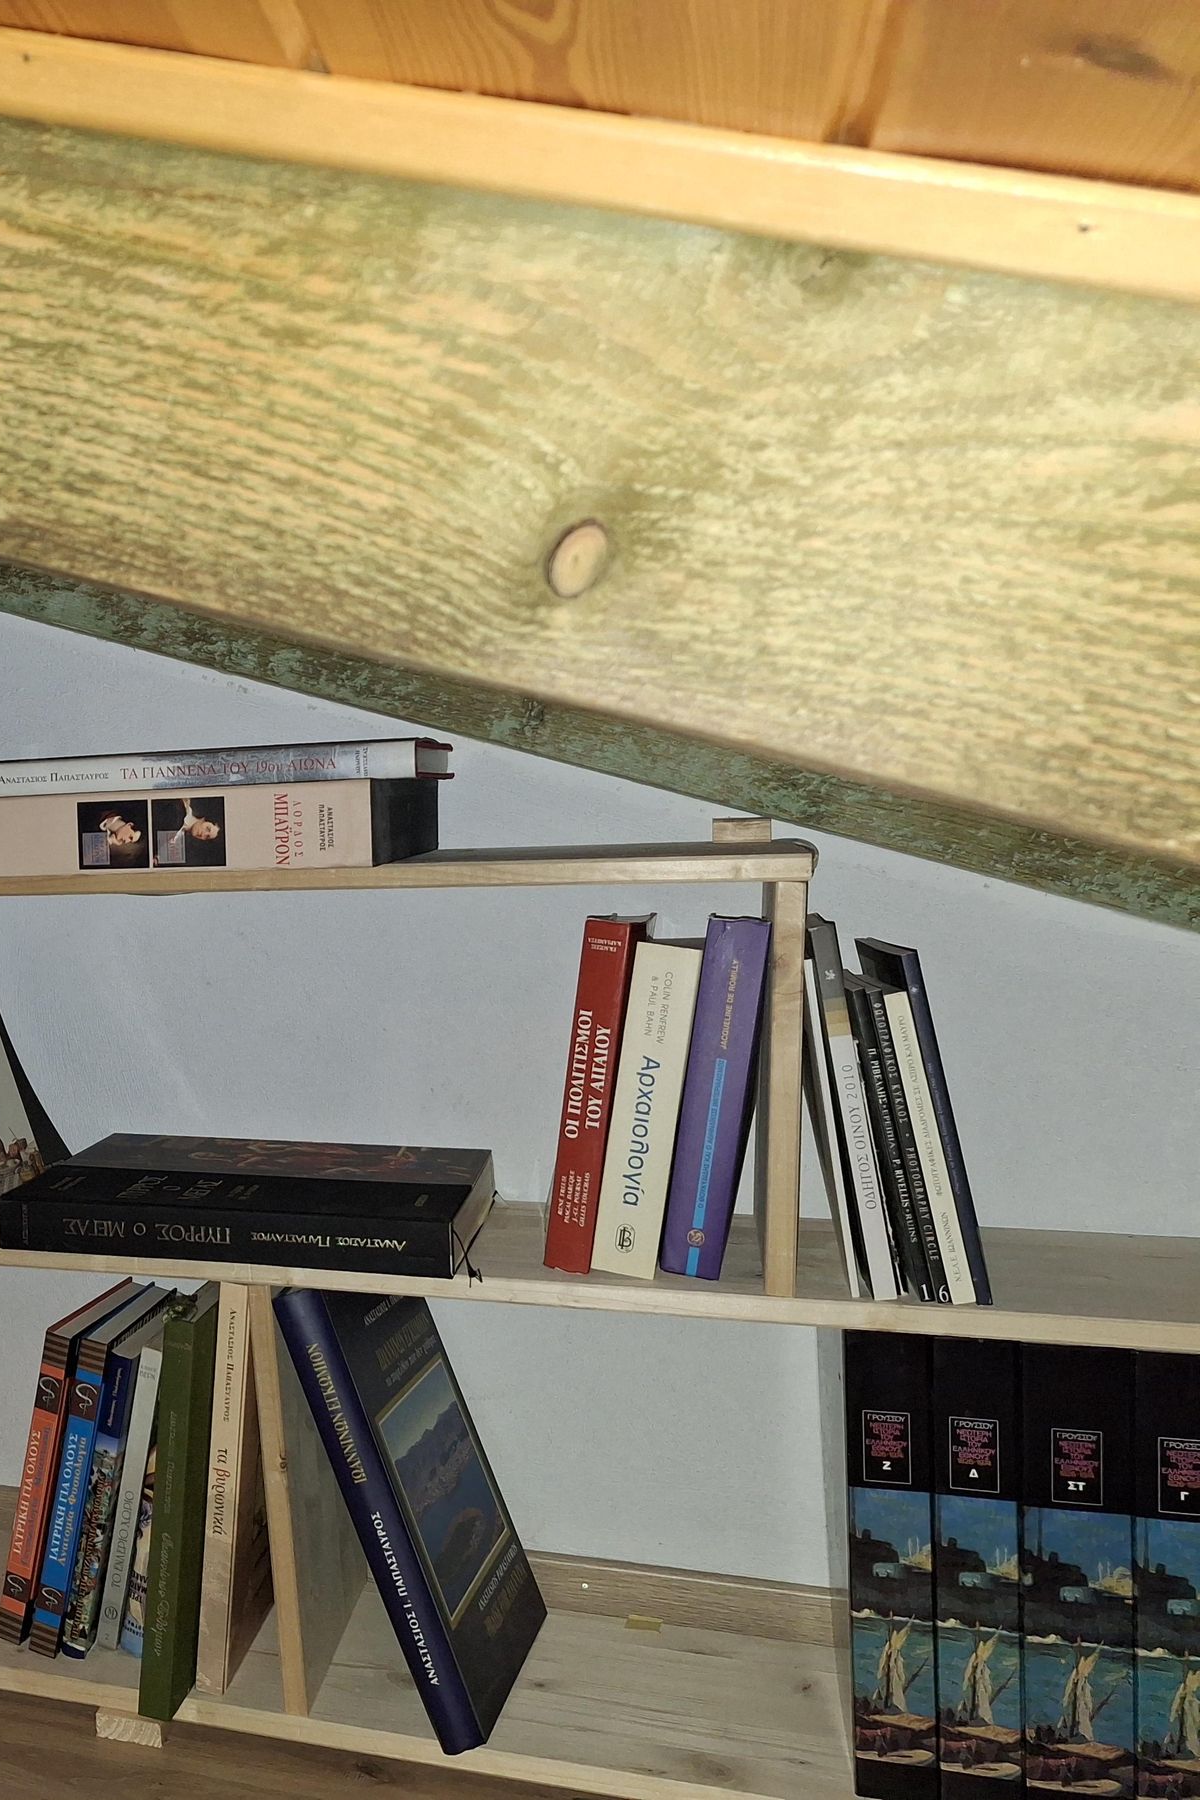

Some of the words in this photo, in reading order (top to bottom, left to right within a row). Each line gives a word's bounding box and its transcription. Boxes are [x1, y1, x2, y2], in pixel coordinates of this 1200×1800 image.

[50, 770, 109, 783] ΠΑΠΑΣΤΑΥΡΟΣ
[120, 767, 140, 781] ΤΑ
[142, 763, 218, 780] ΓΙΑΝΝΕΝΑ
[222, 761, 253, 777] ΤΟΥ
[287, 756, 337, 774] ΑΙΩΝΑ
[273, 793, 293, 866] ΜΠΑΫΡΟΝ
[293, 800, 304, 858] ΛΟΡΔΟΣ
[318, 804, 326, 852] ΠΑΠΑΣΤΑΥΡΟΣ
[326, 806, 335, 848] ΑΝΑΣΤΑΣΙΟΣ
[647, 984, 658, 1007] PAUL
[662, 970, 674, 1000] COLIN
[719, 1004, 733, 1051] JACQUELINE
[726, 958, 739, 992] ROMILLY
[643, 1010, 654, 1037] BAHN
[655, 1004, 671, 1046] RENFREW
[897, 1015, 909, 1043] ΜΑΥΡΟ
[567, 1009, 594, 1116] ΠΟΛΙΤΙΣΜΟΙ
[590, 1023, 612, 1092] ΑΙΓΑΙΟΥ
[906, 1060, 918, 1083] ΑΣΠΡΟ
[842, 1063, 858, 1101] 2010
[564, 1118, 580, 1139] ΟΙ
[585, 1094, 603, 1130] ΤΟΥ
[621, 1055, 661, 1207] Αρχαιολογία
[853, 1105, 870, 1151] ΟΙΝΟΥ
[873, 1001, 898, 1079] ΦΩΤΟΓΡΑΦΙΚΟΣ
[891, 1083, 908, 1124] ΚΥΚΛΟΣ
[905, 1146, 930, 1219] PHOTOGRAPHY
[923, 1225, 939, 1261] CIRCLE
[858, 1152, 878, 1211] ΟΔΗΓΟΣ
[922, 1139, 943, 1197] ΦΩΤΟΓΡΑΦΙΚΕΣ
[63, 1218, 125, 1238] ΜΕΓΑΣ
[133, 1222, 147, 1236] Ο
[154, 1222, 232, 1245] ΠΥΡΡΟΣ
[250, 1230, 331, 1248] ΠΑΠΑΣΤΑΥΡΟΣ
[335, 1236, 406, 1252] ΑΝΑΣΤΑΣΙΟΣ
[939, 1211, 955, 1254] ΙΩΑΝΝΙΝΩΝ
[921, 1284, 929, 1301] 1
[938, 1285, 949, 1302] 6
[225, 1308, 238, 1361] ΑΝΑΣΤΑΣΙΟΣ
[222, 1363, 235, 1423] ΠΑΠΑΣΤΑΥΡΟΣ
[306, 1342, 340, 1411] ΕΓΚΩΜΙΟΝ
[24, 1429, 41, 1474] ΟΛΟΥΣ
[60, 1432, 78, 1480] ΟΛΟΥΣ
[217, 1448, 228, 1464] τα
[330, 1411, 368, 1485] ΙΩΑΝΝΙΝΩΝ
[20, 1475, 34, 1499] ΓΙΑ
[57, 1481, 70, 1504] ΓΙΑ
[968, 1468, 980, 1479] Δ
[1067, 1480, 1087, 1492] ΣΤ
[211, 1467, 230, 1537] βυρωνικά
[1180, 1491, 1190, 1501] Γ
[11, 1499, 31, 1555] ΙΑΤΡΙΚΗ
[48, 1504, 67, 1561] ΙΑΤΡΙΚΗ
[368, 1509, 408, 1598] ΠΑΠΑΣΤΑΥΡΟΣ
[404, 1610, 441, 1687] ΑΝΑΣΤΑΣΙΟΣ
